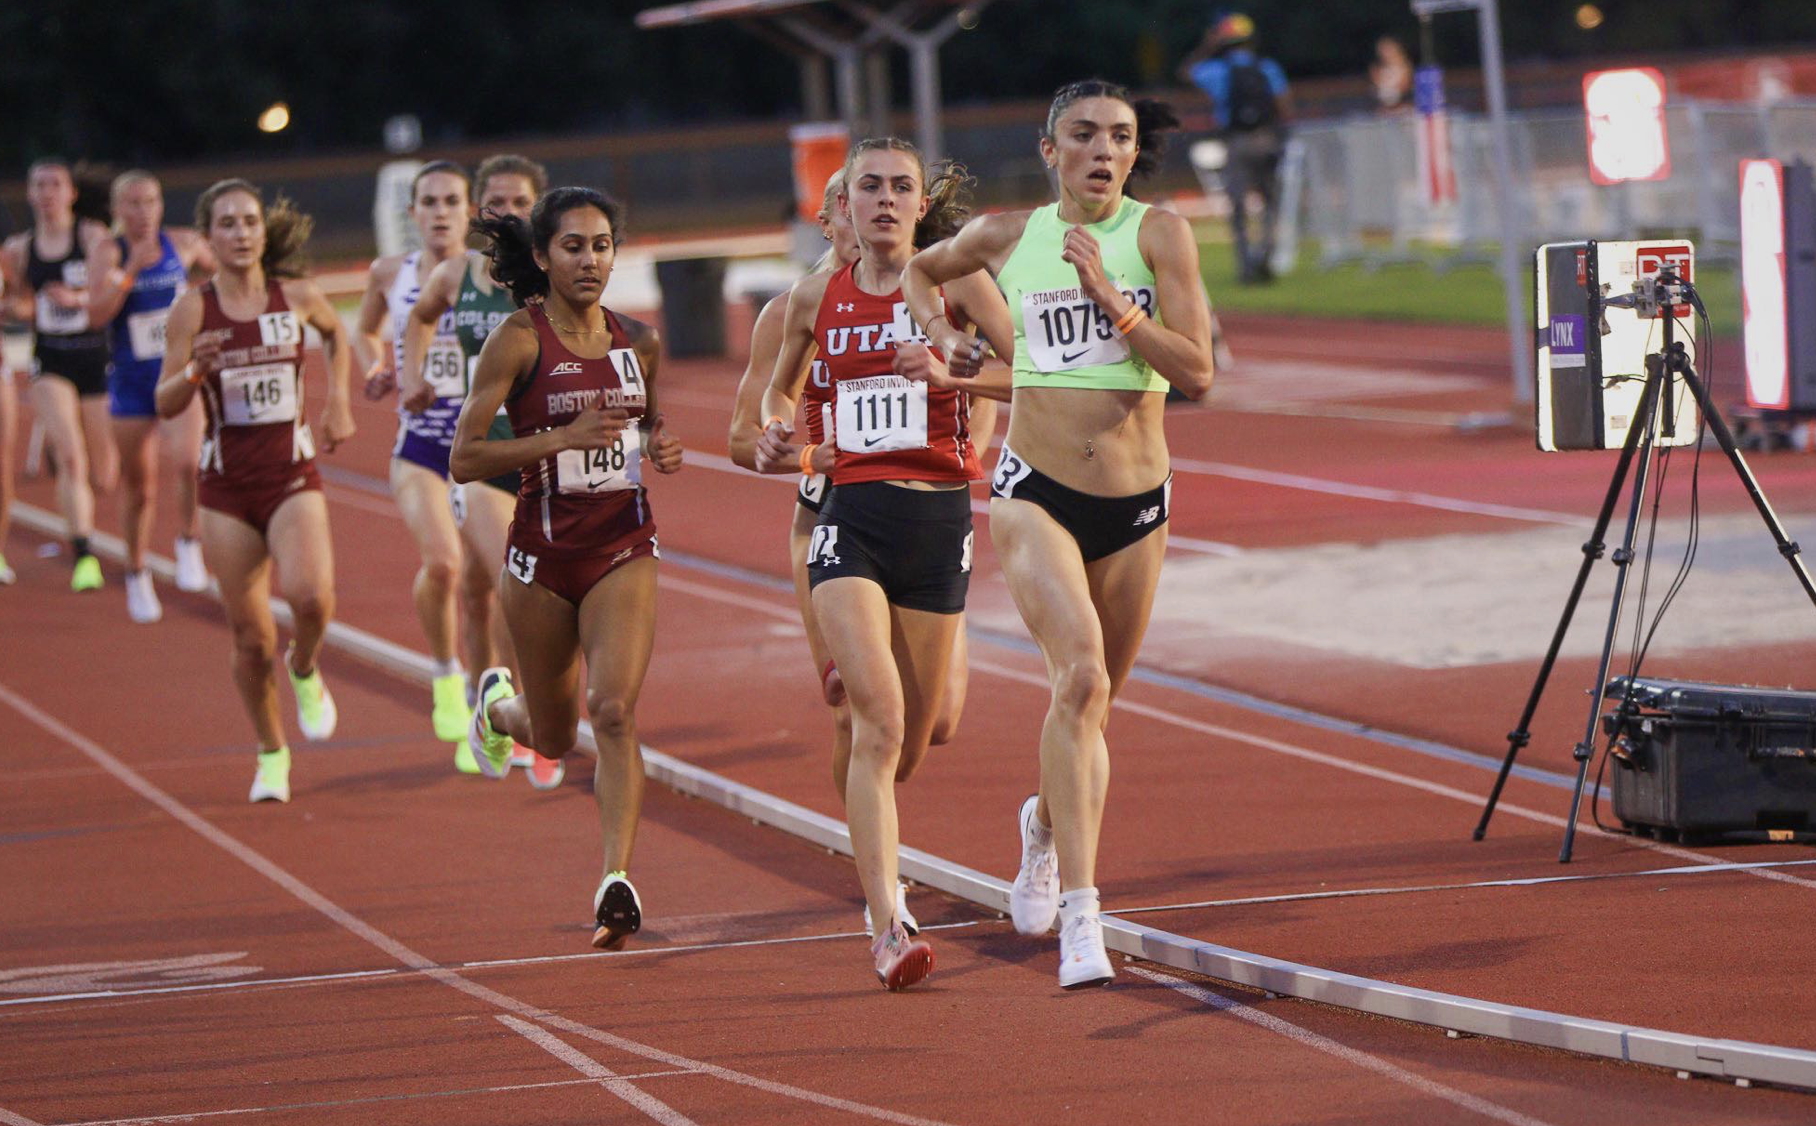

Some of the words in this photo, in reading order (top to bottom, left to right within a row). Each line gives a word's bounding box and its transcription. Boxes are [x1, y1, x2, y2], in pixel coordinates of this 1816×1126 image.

[1033, 288, 1078, 306] STANFORD
[267, 315, 292, 341] 15
[1039, 303, 1114, 347] 1075
[1551, 320, 1574, 347] LYNX
[552, 362, 583, 372] ACC
[622, 351, 642, 392] 4
[243, 379, 281, 406] 146
[846, 377, 886, 394] STANFORD
[854, 393, 908, 432] 1111
[583, 437, 625, 475] 148
[512, 549, 530, 578] 4
